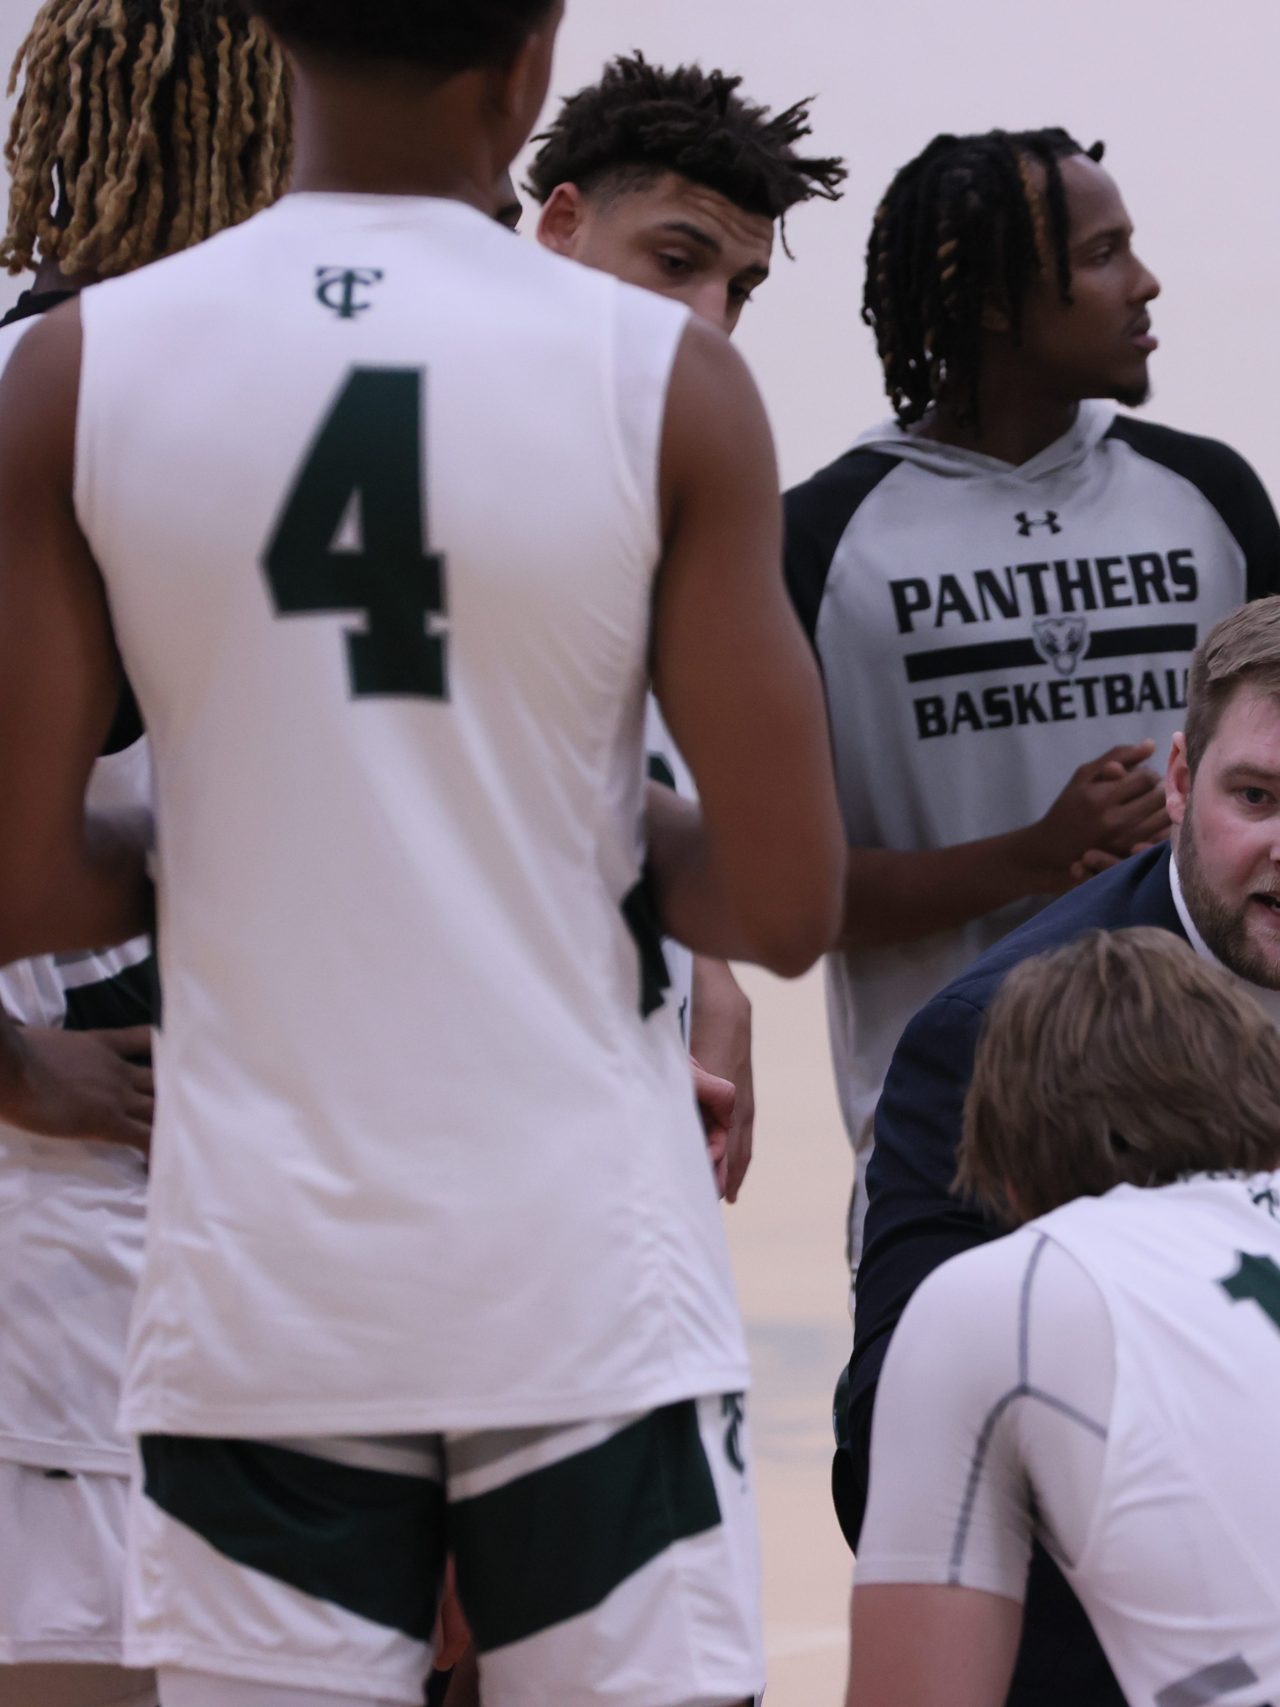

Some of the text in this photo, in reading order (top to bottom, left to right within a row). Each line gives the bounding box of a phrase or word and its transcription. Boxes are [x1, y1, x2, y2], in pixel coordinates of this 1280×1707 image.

[261, 367, 448, 702] 4
[889, 548, 1199, 635] PANTHERS
[913, 668, 1188, 740] BASKETBAL
